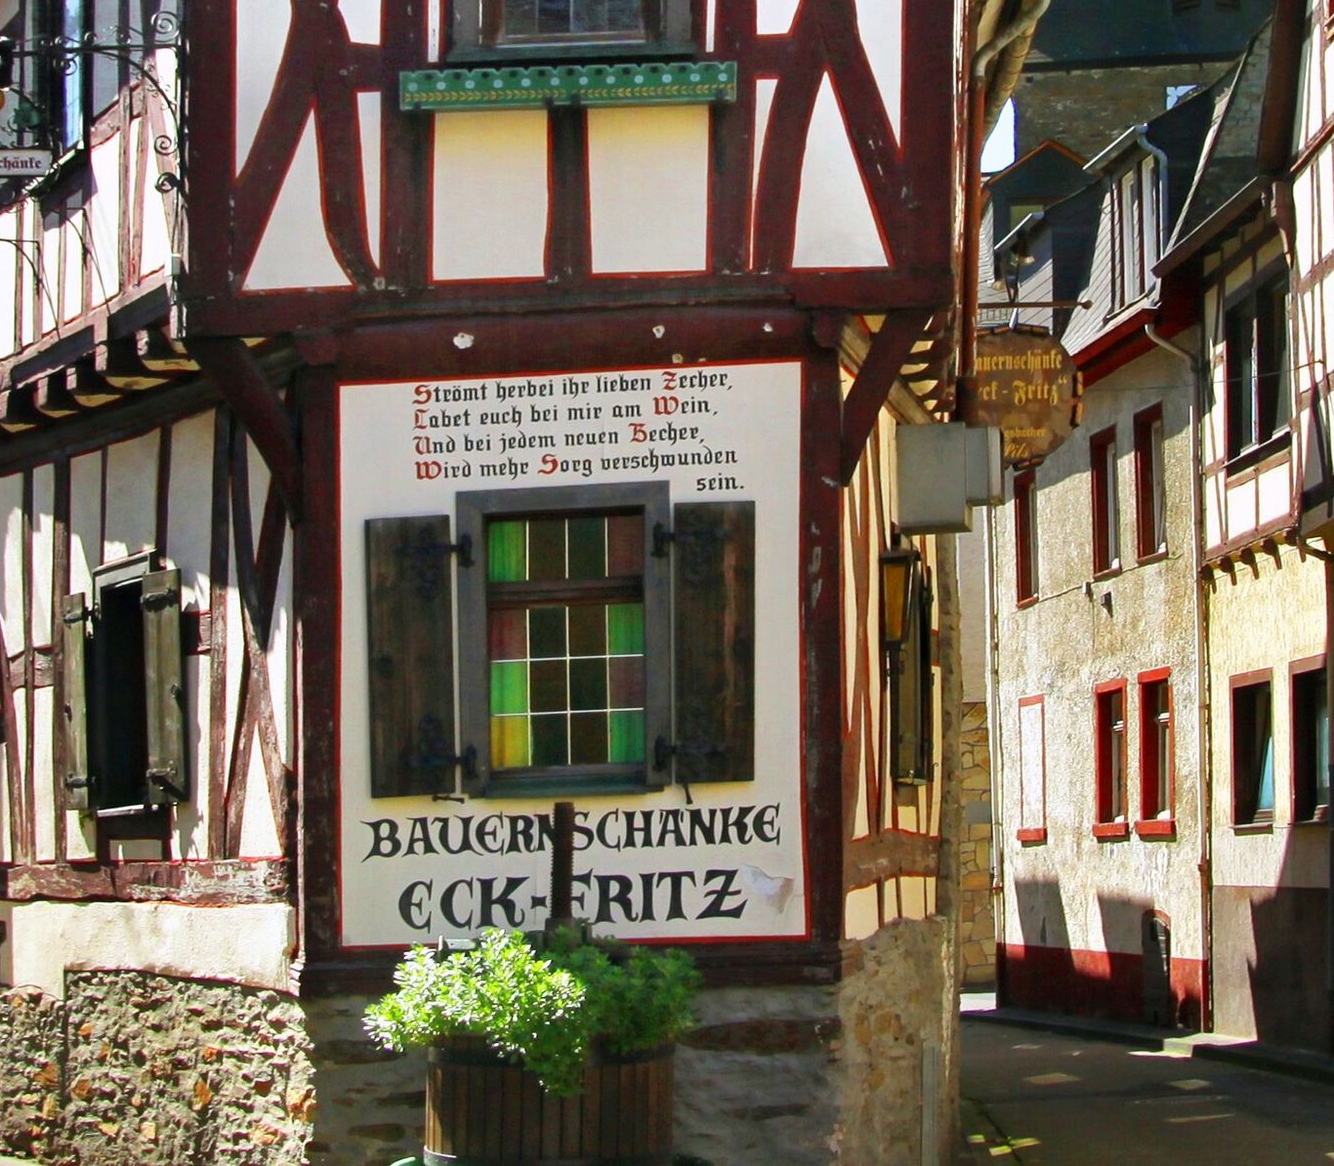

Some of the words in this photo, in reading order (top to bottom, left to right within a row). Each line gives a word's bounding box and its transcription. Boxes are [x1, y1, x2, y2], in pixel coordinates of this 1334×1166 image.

[975, 349, 1062, 372] auernschänke
[412, 383, 488, 405] Strömt
[495, 379, 554, 402] herbei
[562, 376, 590, 399] ihr
[596, 374, 652, 393] lieben
[661, 369, 733, 391] Zecher,
[413, 408, 471, 430] Labet
[479, 405, 522, 427] euch
[530, 404, 558, 423] bei
[567, 402, 602, 421] mir
[612, 404, 642, 418] am
[653, 396, 719, 416] Wein,
[413, 431, 456, 455] Und
[463, 434, 492, 452] bei
[499, 431, 556, 454] jedem
[564, 431, 619, 447] neuen
[628, 421, 705, 445] Becher,
[414, 458, 472, 480] Wird
[479, 457, 529, 481] mehr
[537, 453, 593, 477] Sorg
[601, 445, 738, 474] verschwunden
[696, 472, 745, 491] sein.
